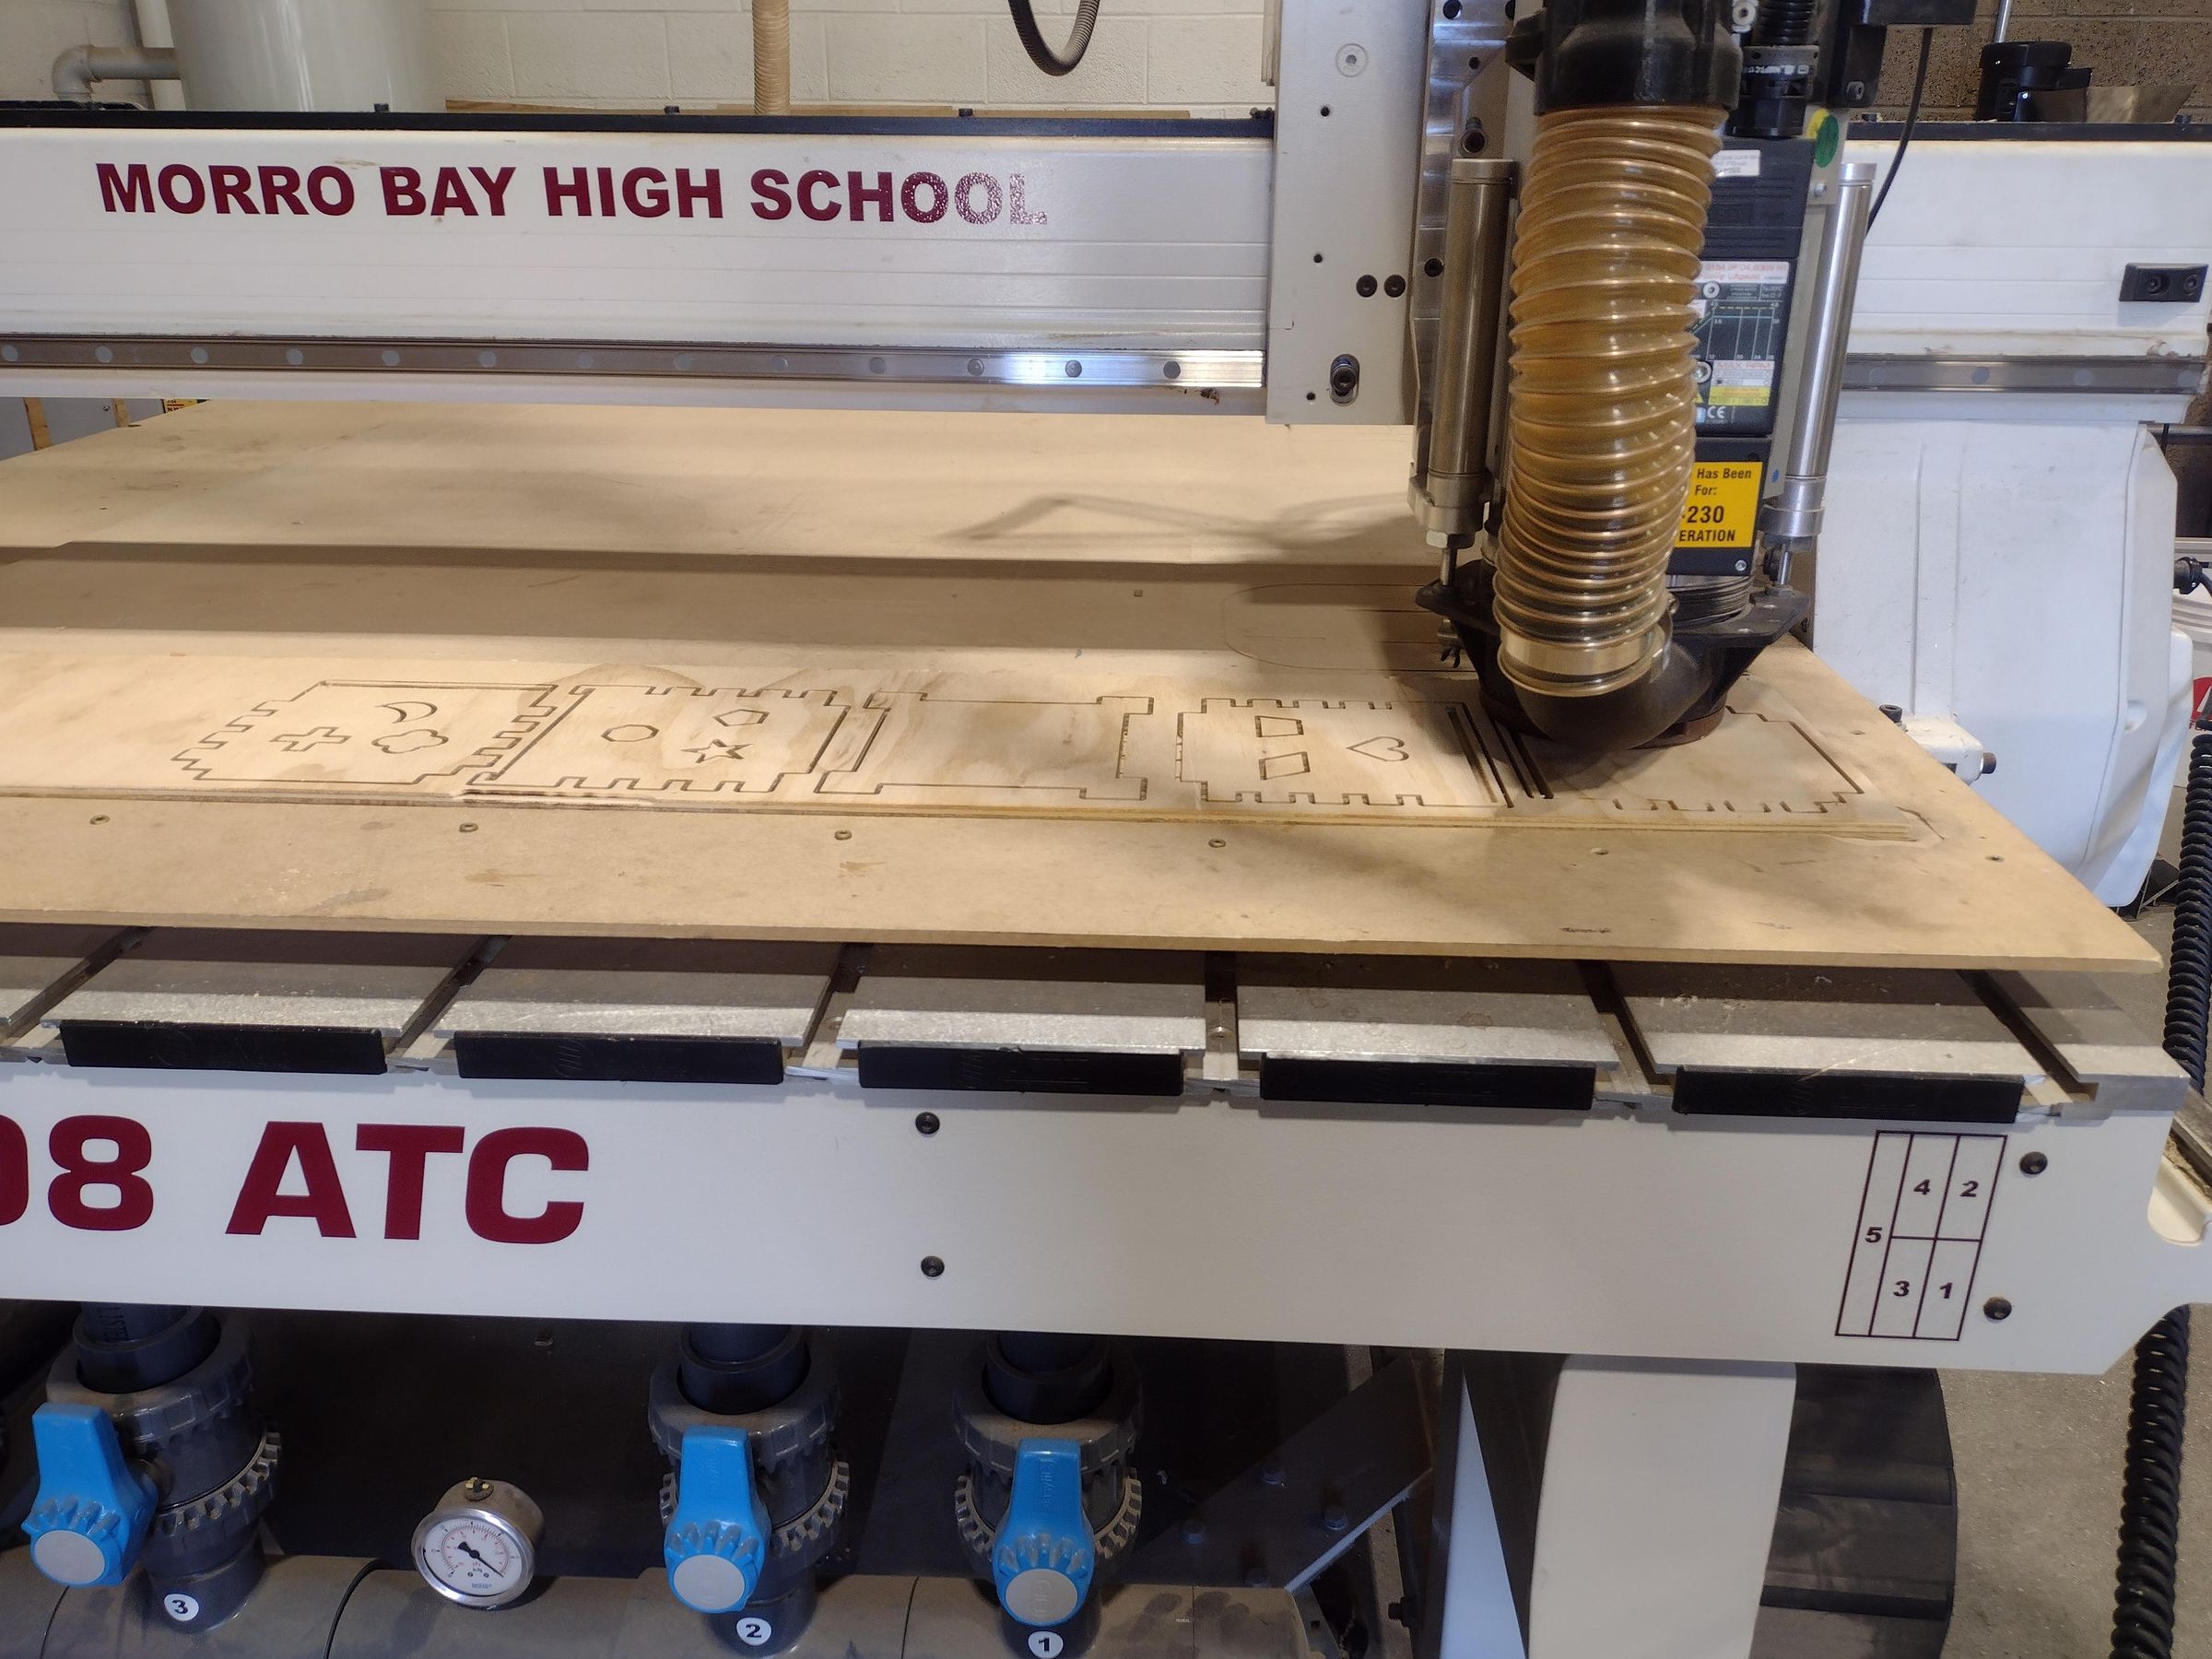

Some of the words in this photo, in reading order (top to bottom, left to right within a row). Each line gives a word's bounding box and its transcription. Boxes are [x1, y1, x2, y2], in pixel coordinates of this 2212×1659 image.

[96, 163, 355, 217] MORRO
[380, 167, 516, 217] BAY
[544, 167, 724, 218] HIGH
[750, 169, 1048, 225] SCHOOL
[1697, 467, 1718, 478] Has
[1723, 467, 1751, 478] Been
[1694, 484, 1717, 495] For:
[0, 1114, 154, 1231] 8
[226, 1121, 590, 1244] ATC
[1913, 1179, 1931, 1195] 4
[1959, 1180, 1979, 1197] 2
[1865, 1226, 1883, 1243] 5
[1892, 1280, 1910, 1298] 3
[1939, 1282, 1953, 1299] 1
[172, 1599, 189, 1614] 3
[746, 1624, 762, 1638] 2
[1038, 1637, 1050, 1652] 1
